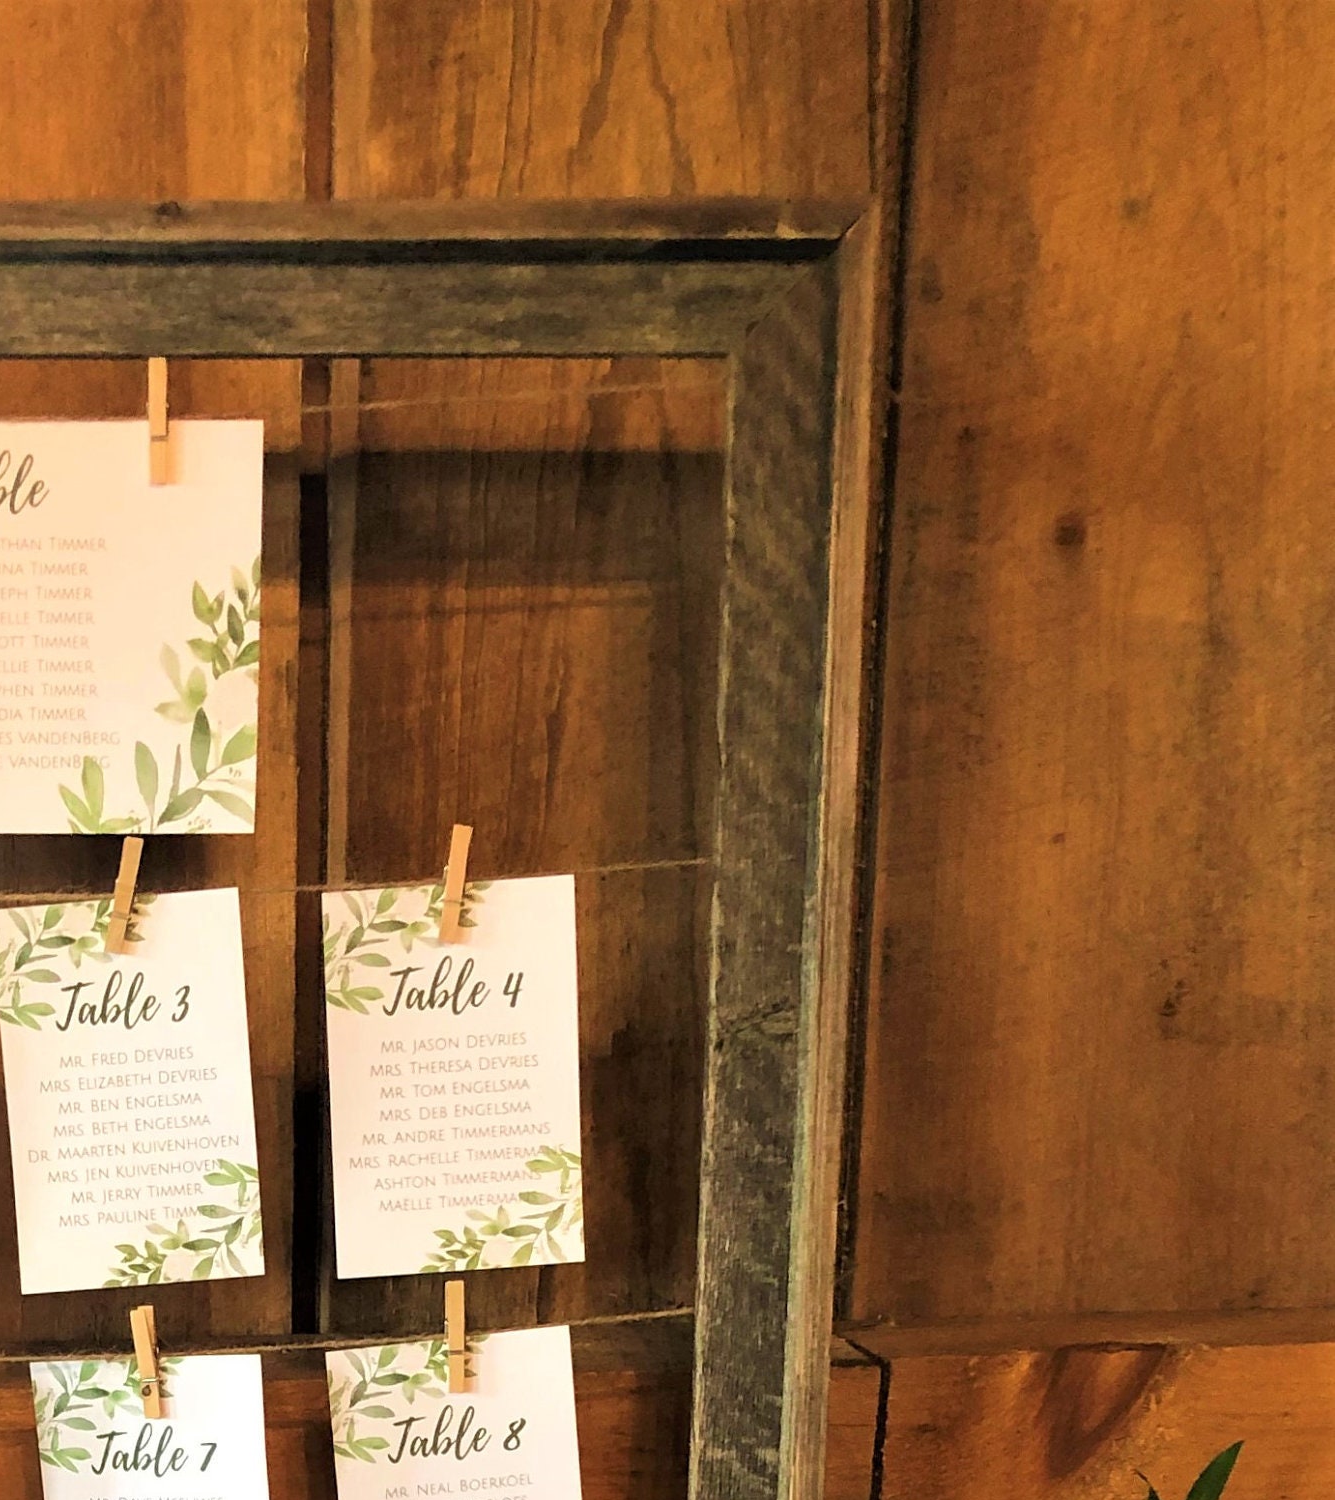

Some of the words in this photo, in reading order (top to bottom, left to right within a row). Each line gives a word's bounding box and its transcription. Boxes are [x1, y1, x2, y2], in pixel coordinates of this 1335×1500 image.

[383, 955, 490, 1015] Table
[503, 972, 524, 1008] 4
[56, 970, 161, 1032] Table
[172, 986, 189, 1022] 3
[412, 1037, 460, 1056] JASON
[91, 1051, 129, 1067] FRED
[77, 1072, 152, 1091] ELIZABETH
[412, 1083, 447, 1098] TOM
[451, 1078, 531, 1096] ENGELSMA
[388, 1405, 491, 1465] Table
[504, 1417, 526, 1451] 8
[91, 1423, 188, 1478] Table
[200, 1443, 217, 1472] 7
[416, 1482, 455, 1497] NEAL
[459, 1473, 533, 1493] BOERKOEL
